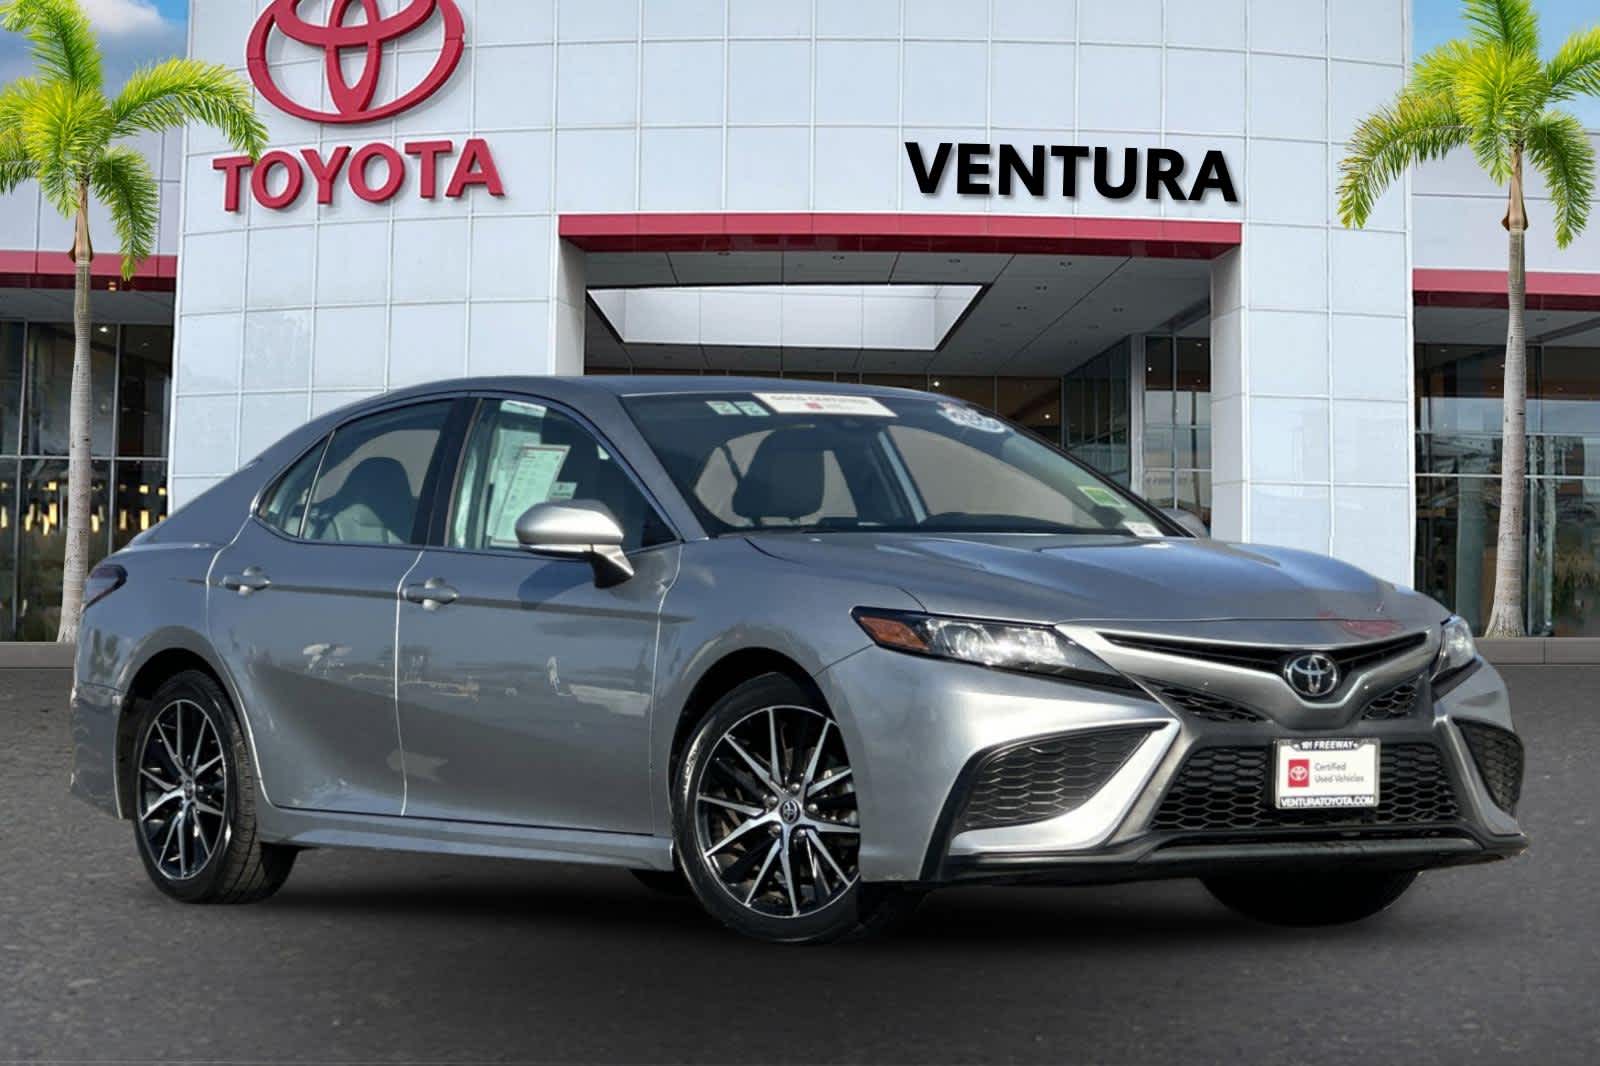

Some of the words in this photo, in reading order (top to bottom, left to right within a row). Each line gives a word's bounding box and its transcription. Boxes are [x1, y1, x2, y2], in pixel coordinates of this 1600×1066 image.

[212, 139, 505, 212] TOYOTA
[904, 141, 1239, 202] VENTURA
[1314, 741, 1354, 749] FREEWAY
[1314, 762, 1347, 772] Certified
[1314, 775, 1334, 784] Used
[1335, 773, 1364, 783] Vehicles
[1280, 797, 1374, 807] VENTURATOYOTA.COM
